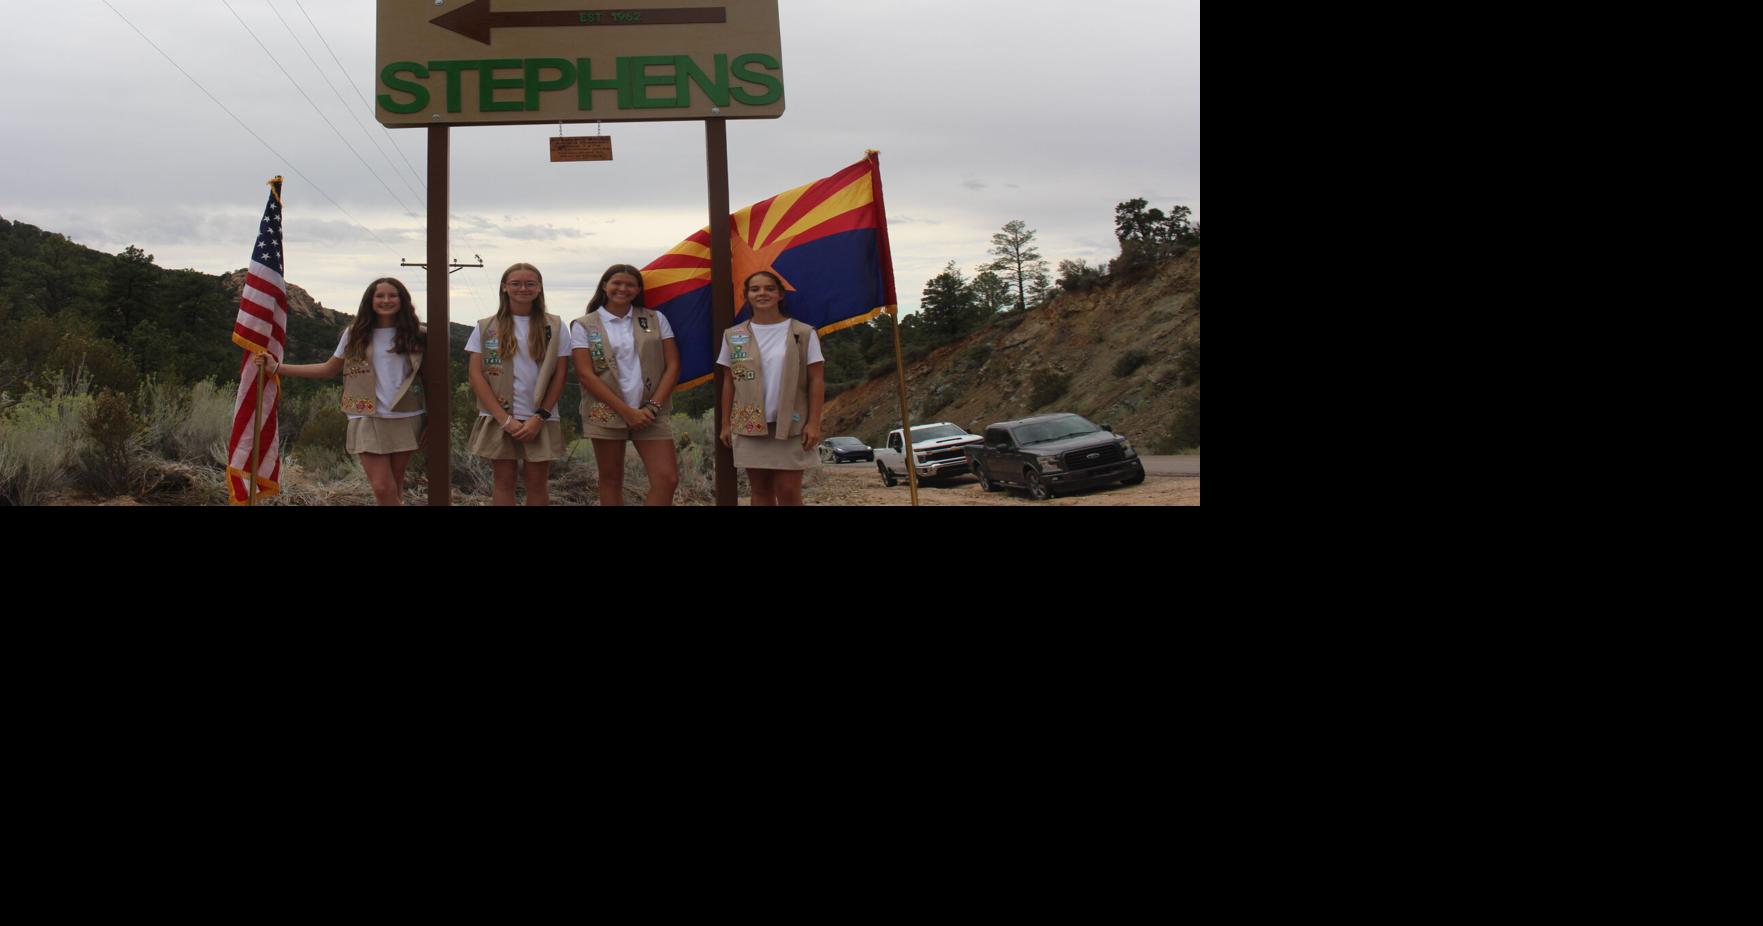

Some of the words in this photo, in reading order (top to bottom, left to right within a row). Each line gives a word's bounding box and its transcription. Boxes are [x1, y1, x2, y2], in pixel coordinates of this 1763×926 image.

[578, 12, 602, 23] EST
[611, 11, 641, 22] 1962
[377, 53, 783, 114] STEPHENS
